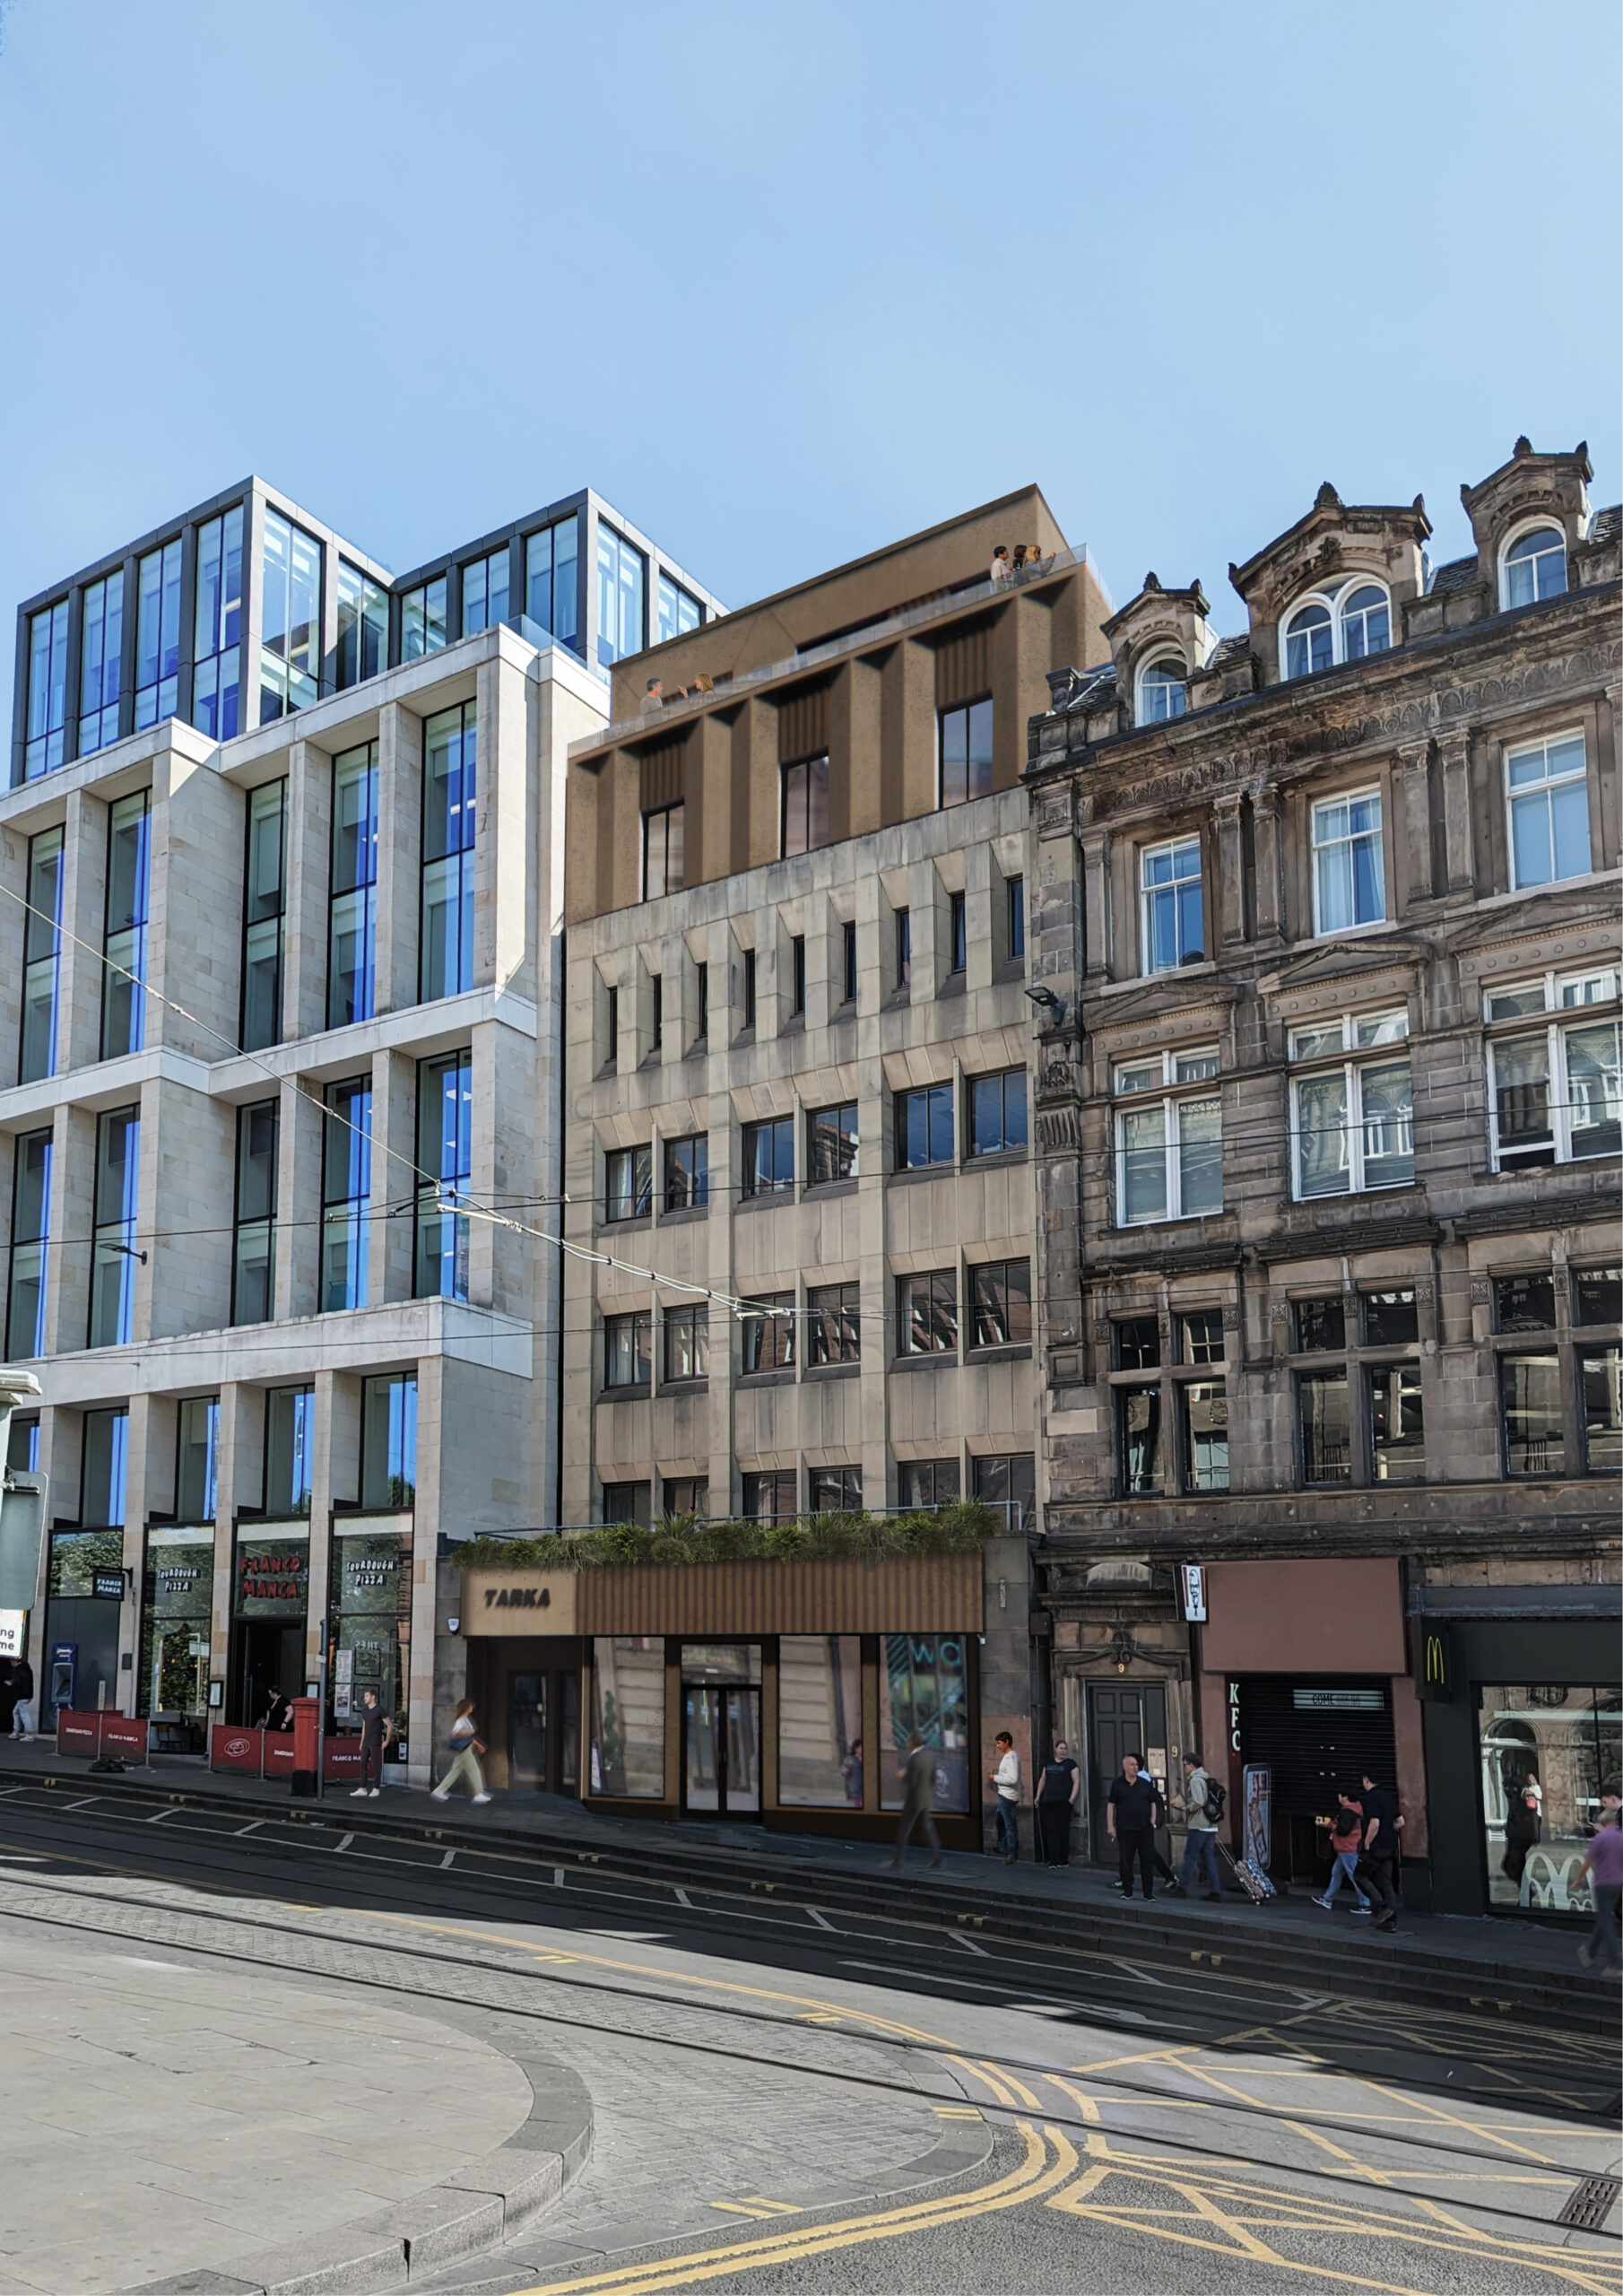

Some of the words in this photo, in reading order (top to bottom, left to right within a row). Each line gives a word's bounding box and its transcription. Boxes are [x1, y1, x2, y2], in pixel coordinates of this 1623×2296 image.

[240, 1555, 300, 1574] FRANCO
[346, 1561, 395, 1571] SOURDOUGH
[157, 1569, 198, 1578] SOURDOUGH
[97, 1578, 122, 1587] FRANCO
[355, 1575, 384, 1586] PIZZA
[97, 1586, 121, 1594] MANCA
[164, 1581, 190, 1592] PIZZA
[240, 1579, 299, 1599] MANCA
[485, 1588, 551, 1607] TARKA
[1117, 1664, 1124, 1673] 9
[1229, 1683, 1241, 1752] KFC
[1171, 1745, 1178, 1757] 9
